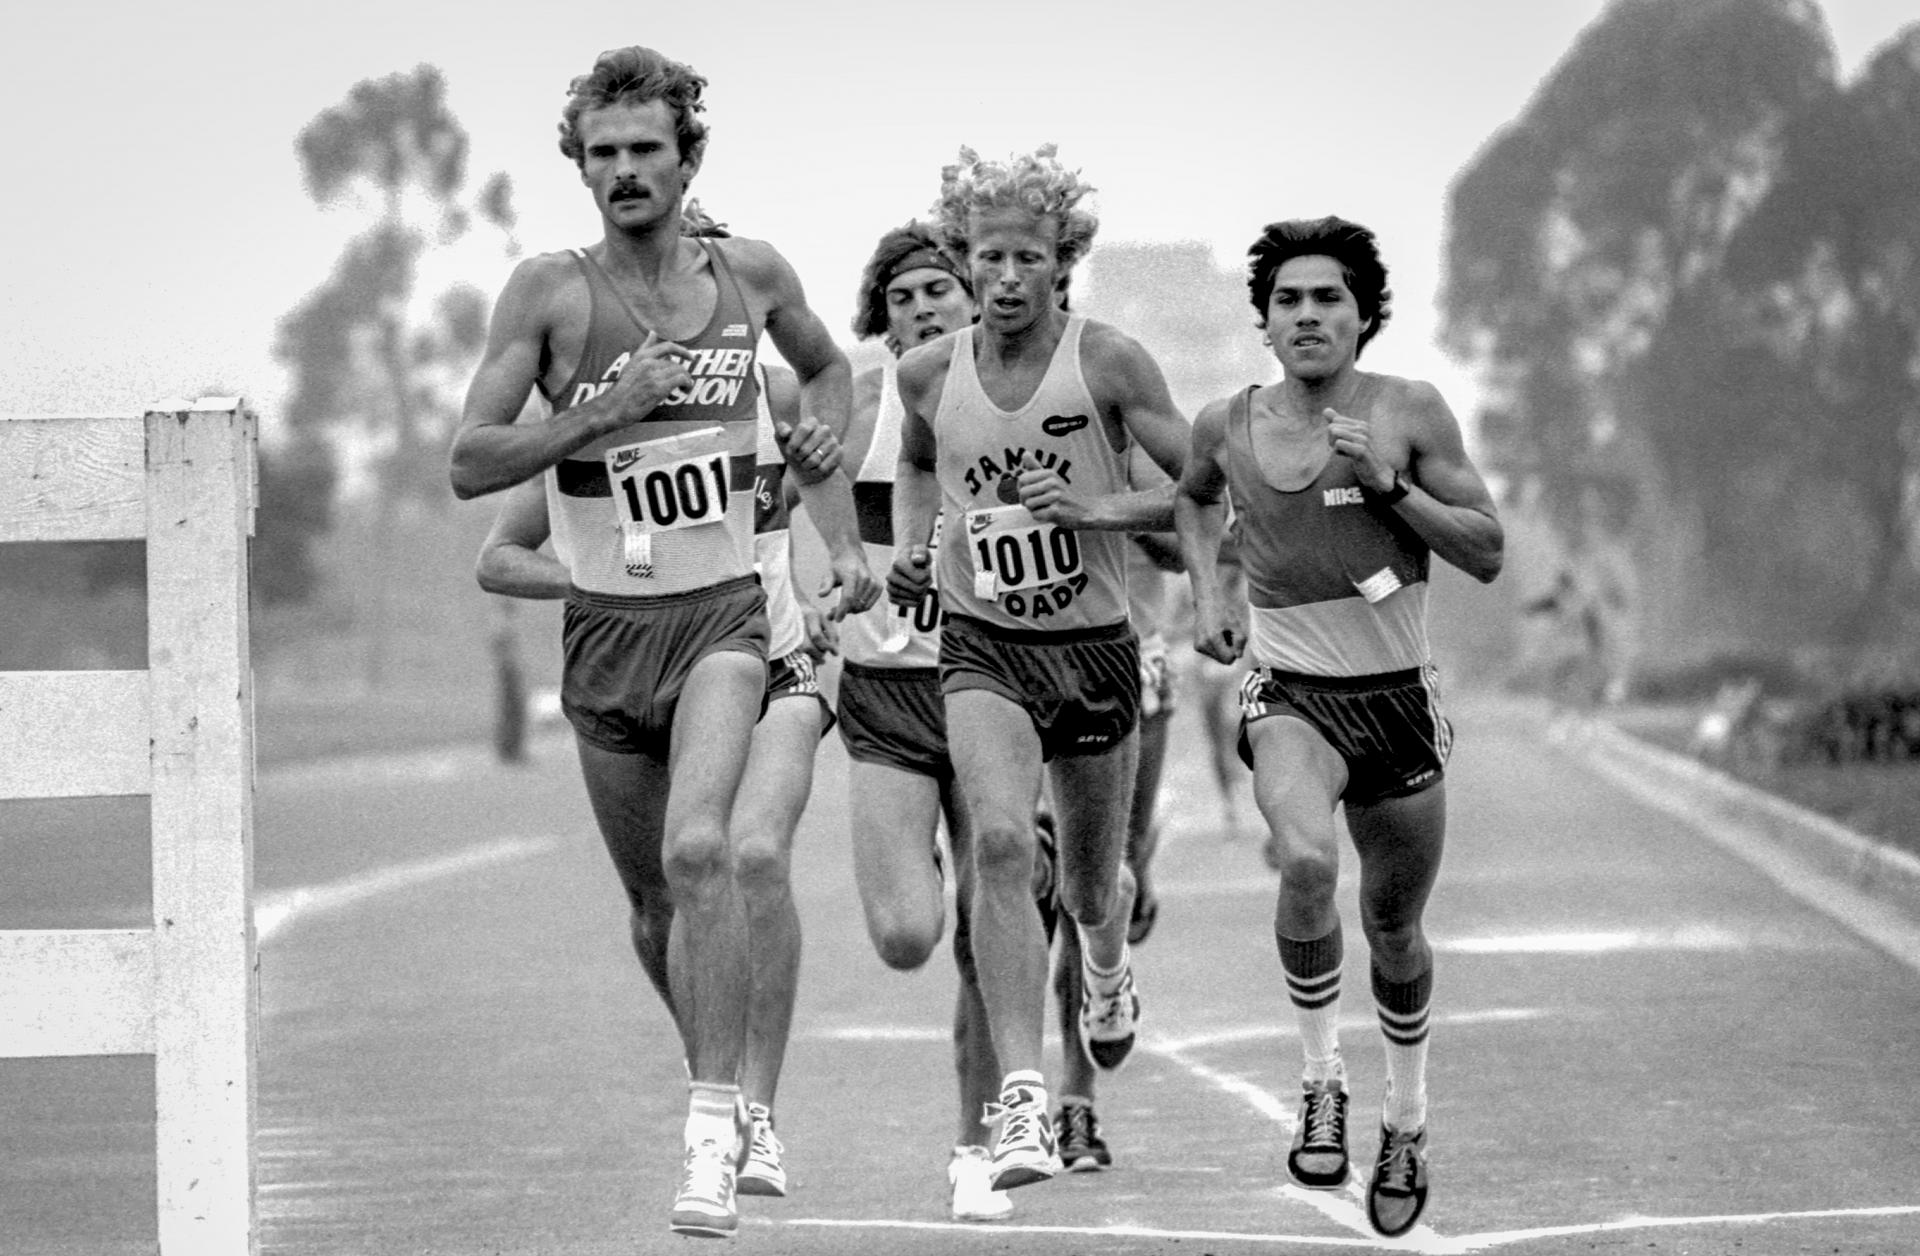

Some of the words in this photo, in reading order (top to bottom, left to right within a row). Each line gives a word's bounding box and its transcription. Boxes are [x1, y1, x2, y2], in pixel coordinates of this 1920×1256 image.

[601, 349, 752, 380] ATHER
[621, 457, 728, 526] 1001
[1323, 486, 1364, 506] NIKE
[976, 526, 1080, 586] 1010
[988, 573, 1088, 619] OADS
